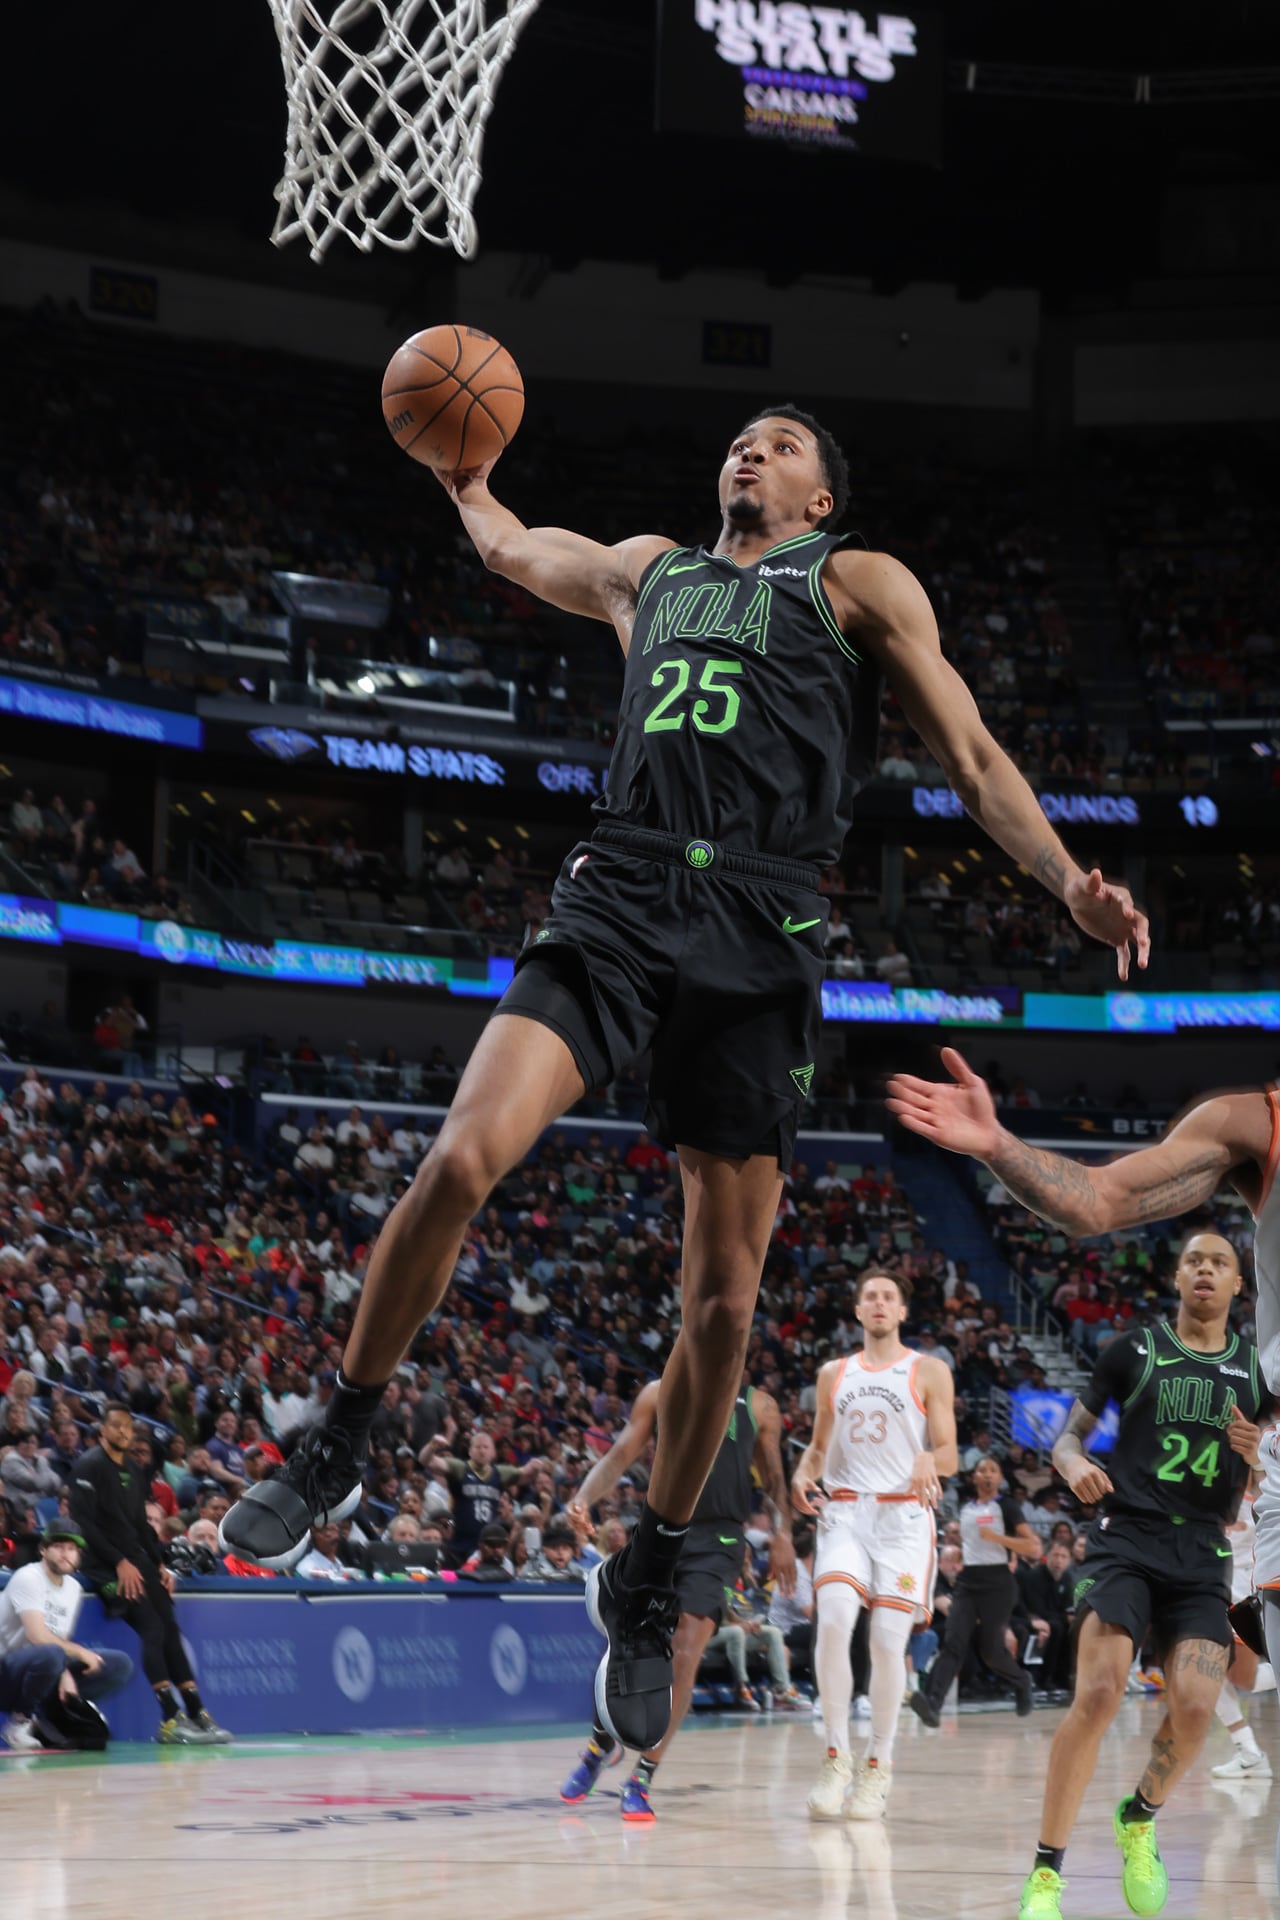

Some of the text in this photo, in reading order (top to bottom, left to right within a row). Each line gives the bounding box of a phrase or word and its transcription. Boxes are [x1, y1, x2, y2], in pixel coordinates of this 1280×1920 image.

[694, 0, 918, 55] HUSTLE
[715, 26, 896, 82] STATS
[642, 579, 772, 655] NOLA
[643, 658, 744, 734] 25
[322, 734, 405, 775] TEAM
[1219, 1364, 1249, 1379] ibotta
[857, 1385, 905, 1413] ANTONIO
[1155, 1376, 1238, 1430] NOLA
[849, 1409, 887, 1444] 23
[1157, 1432, 1220, 1487] 24
[474, 1500, 492, 1522] 15
